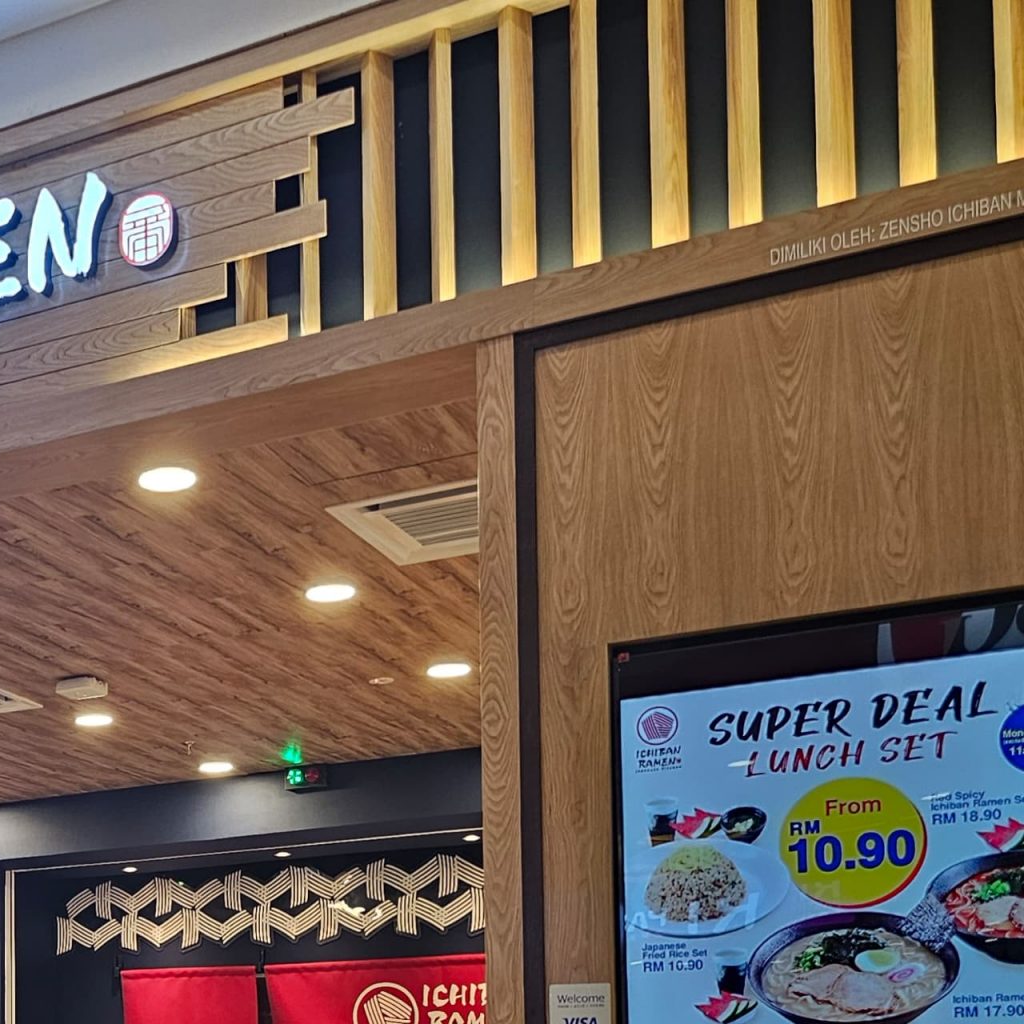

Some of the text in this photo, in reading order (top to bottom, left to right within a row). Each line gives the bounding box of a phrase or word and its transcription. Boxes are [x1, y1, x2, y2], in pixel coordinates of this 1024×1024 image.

[770, 236, 826, 266] DIMILIKI
[830, 224, 876, 251] OLEH:
[879, 208, 944, 241] ZENSHO
[948, 192, 1012, 225] ICHIBAN
[709, 681, 998, 746] SUPER DEAL
[743, 730, 959, 778] LUNCH SET
[955, 791, 986, 802] Spicy
[825, 799, 881, 817] From
[930, 800, 969, 812] Ichiban
[973, 797, 1011, 808] Ramen
[932, 808, 1002, 825] RM 18.90
[789, 819, 821, 837] RM
[788, 828, 916, 874] 10.90
[642, 943, 687, 952] Japanese
[642, 948, 708, 960] Fried Rice Set
[643, 959, 703, 973] RM 10.90
[557, 993, 605, 1004] Welcome
[952, 994, 993, 1004] Ichiban
[953, 1004, 1024, 1018] RM 17.90
